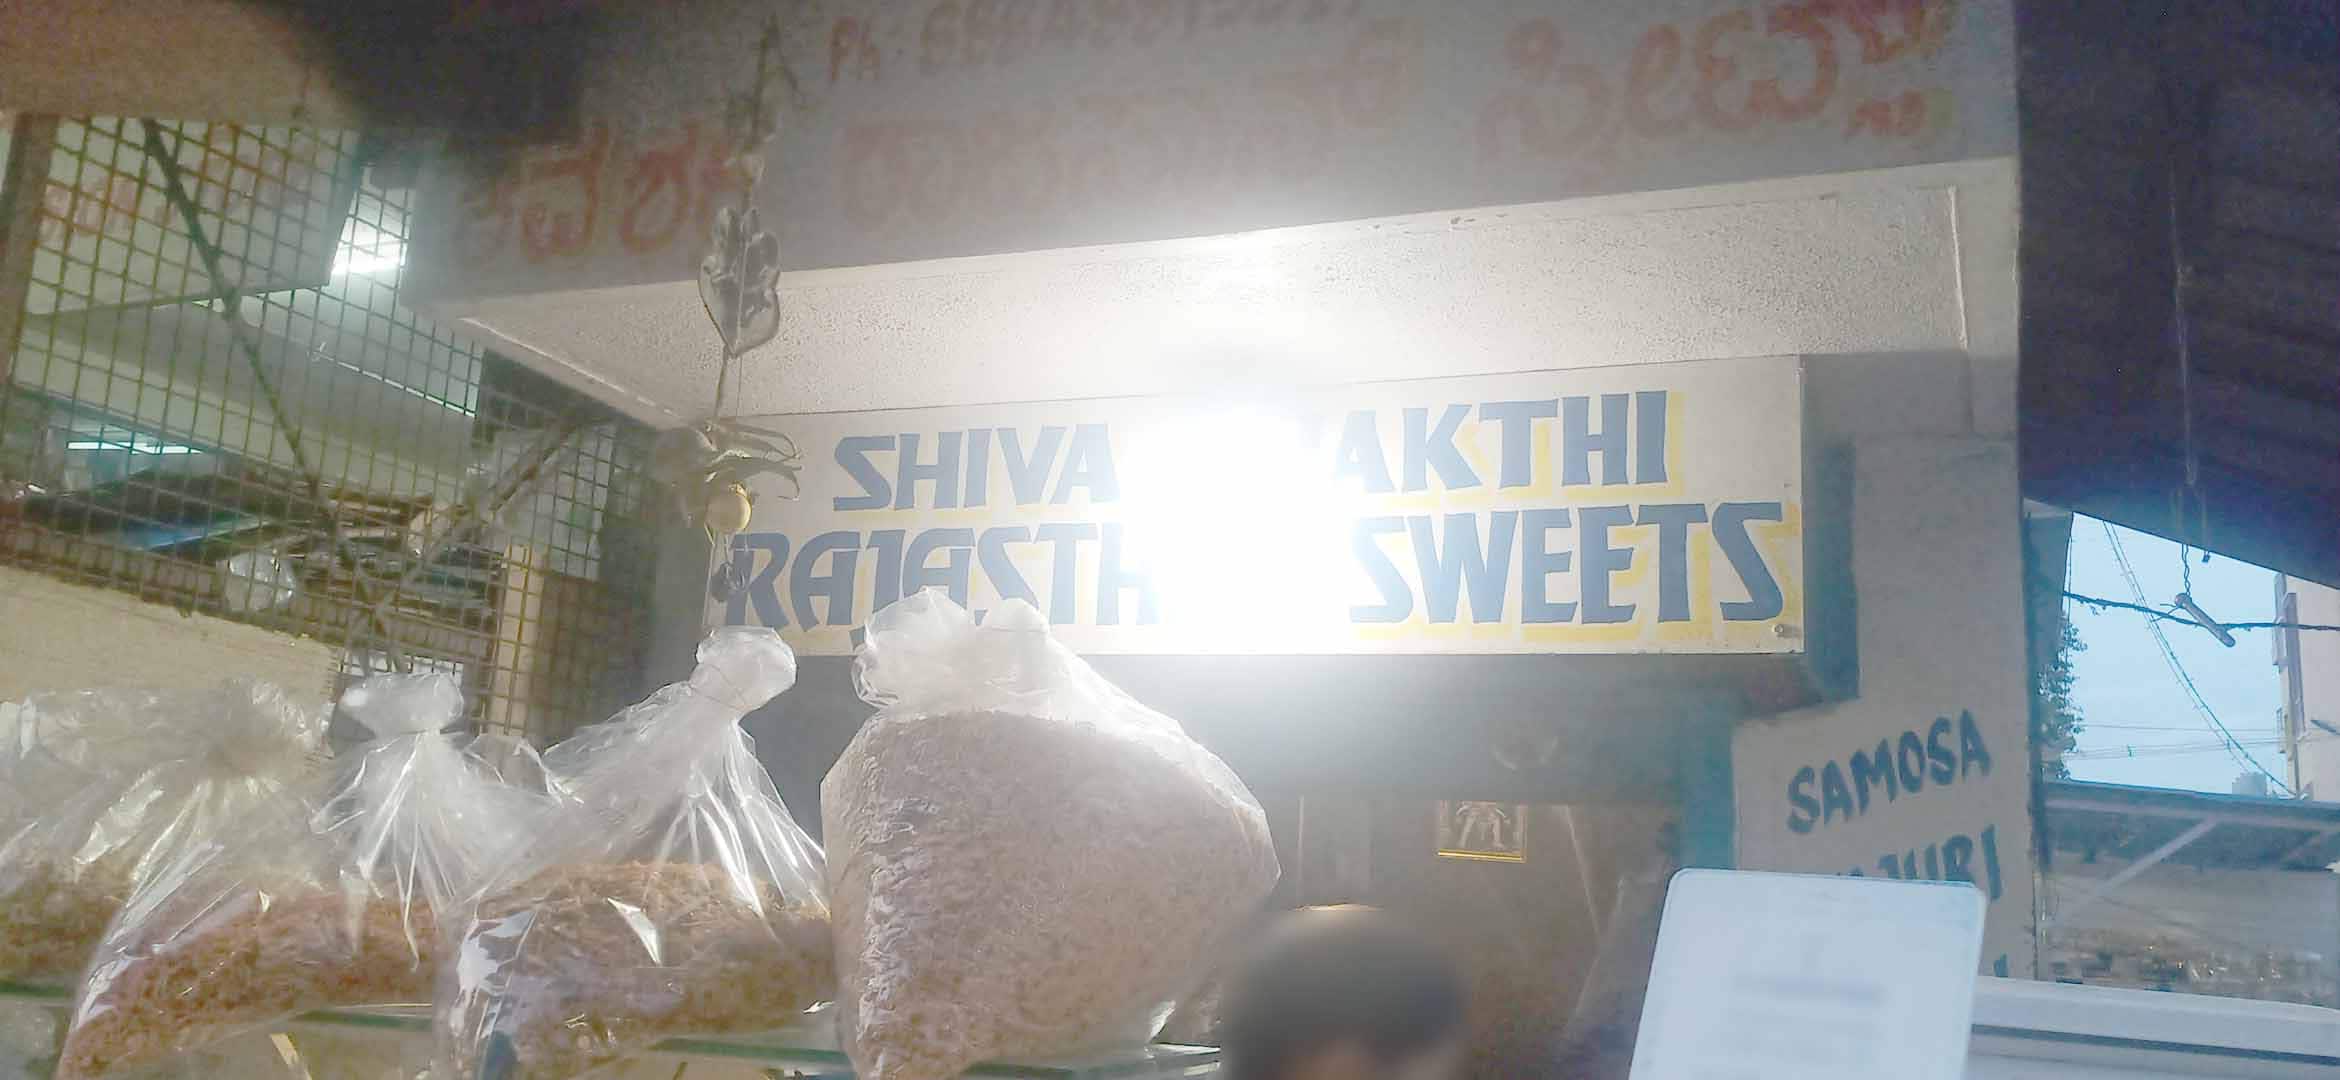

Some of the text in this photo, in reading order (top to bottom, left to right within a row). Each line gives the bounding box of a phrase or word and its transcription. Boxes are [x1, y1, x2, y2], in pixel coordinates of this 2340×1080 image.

[833, 390, 1668, 511] SHIVA AKTHI
[1349, 502, 1785, 624] SWEETS
[1787, 709, 1991, 834] SAMOSA
